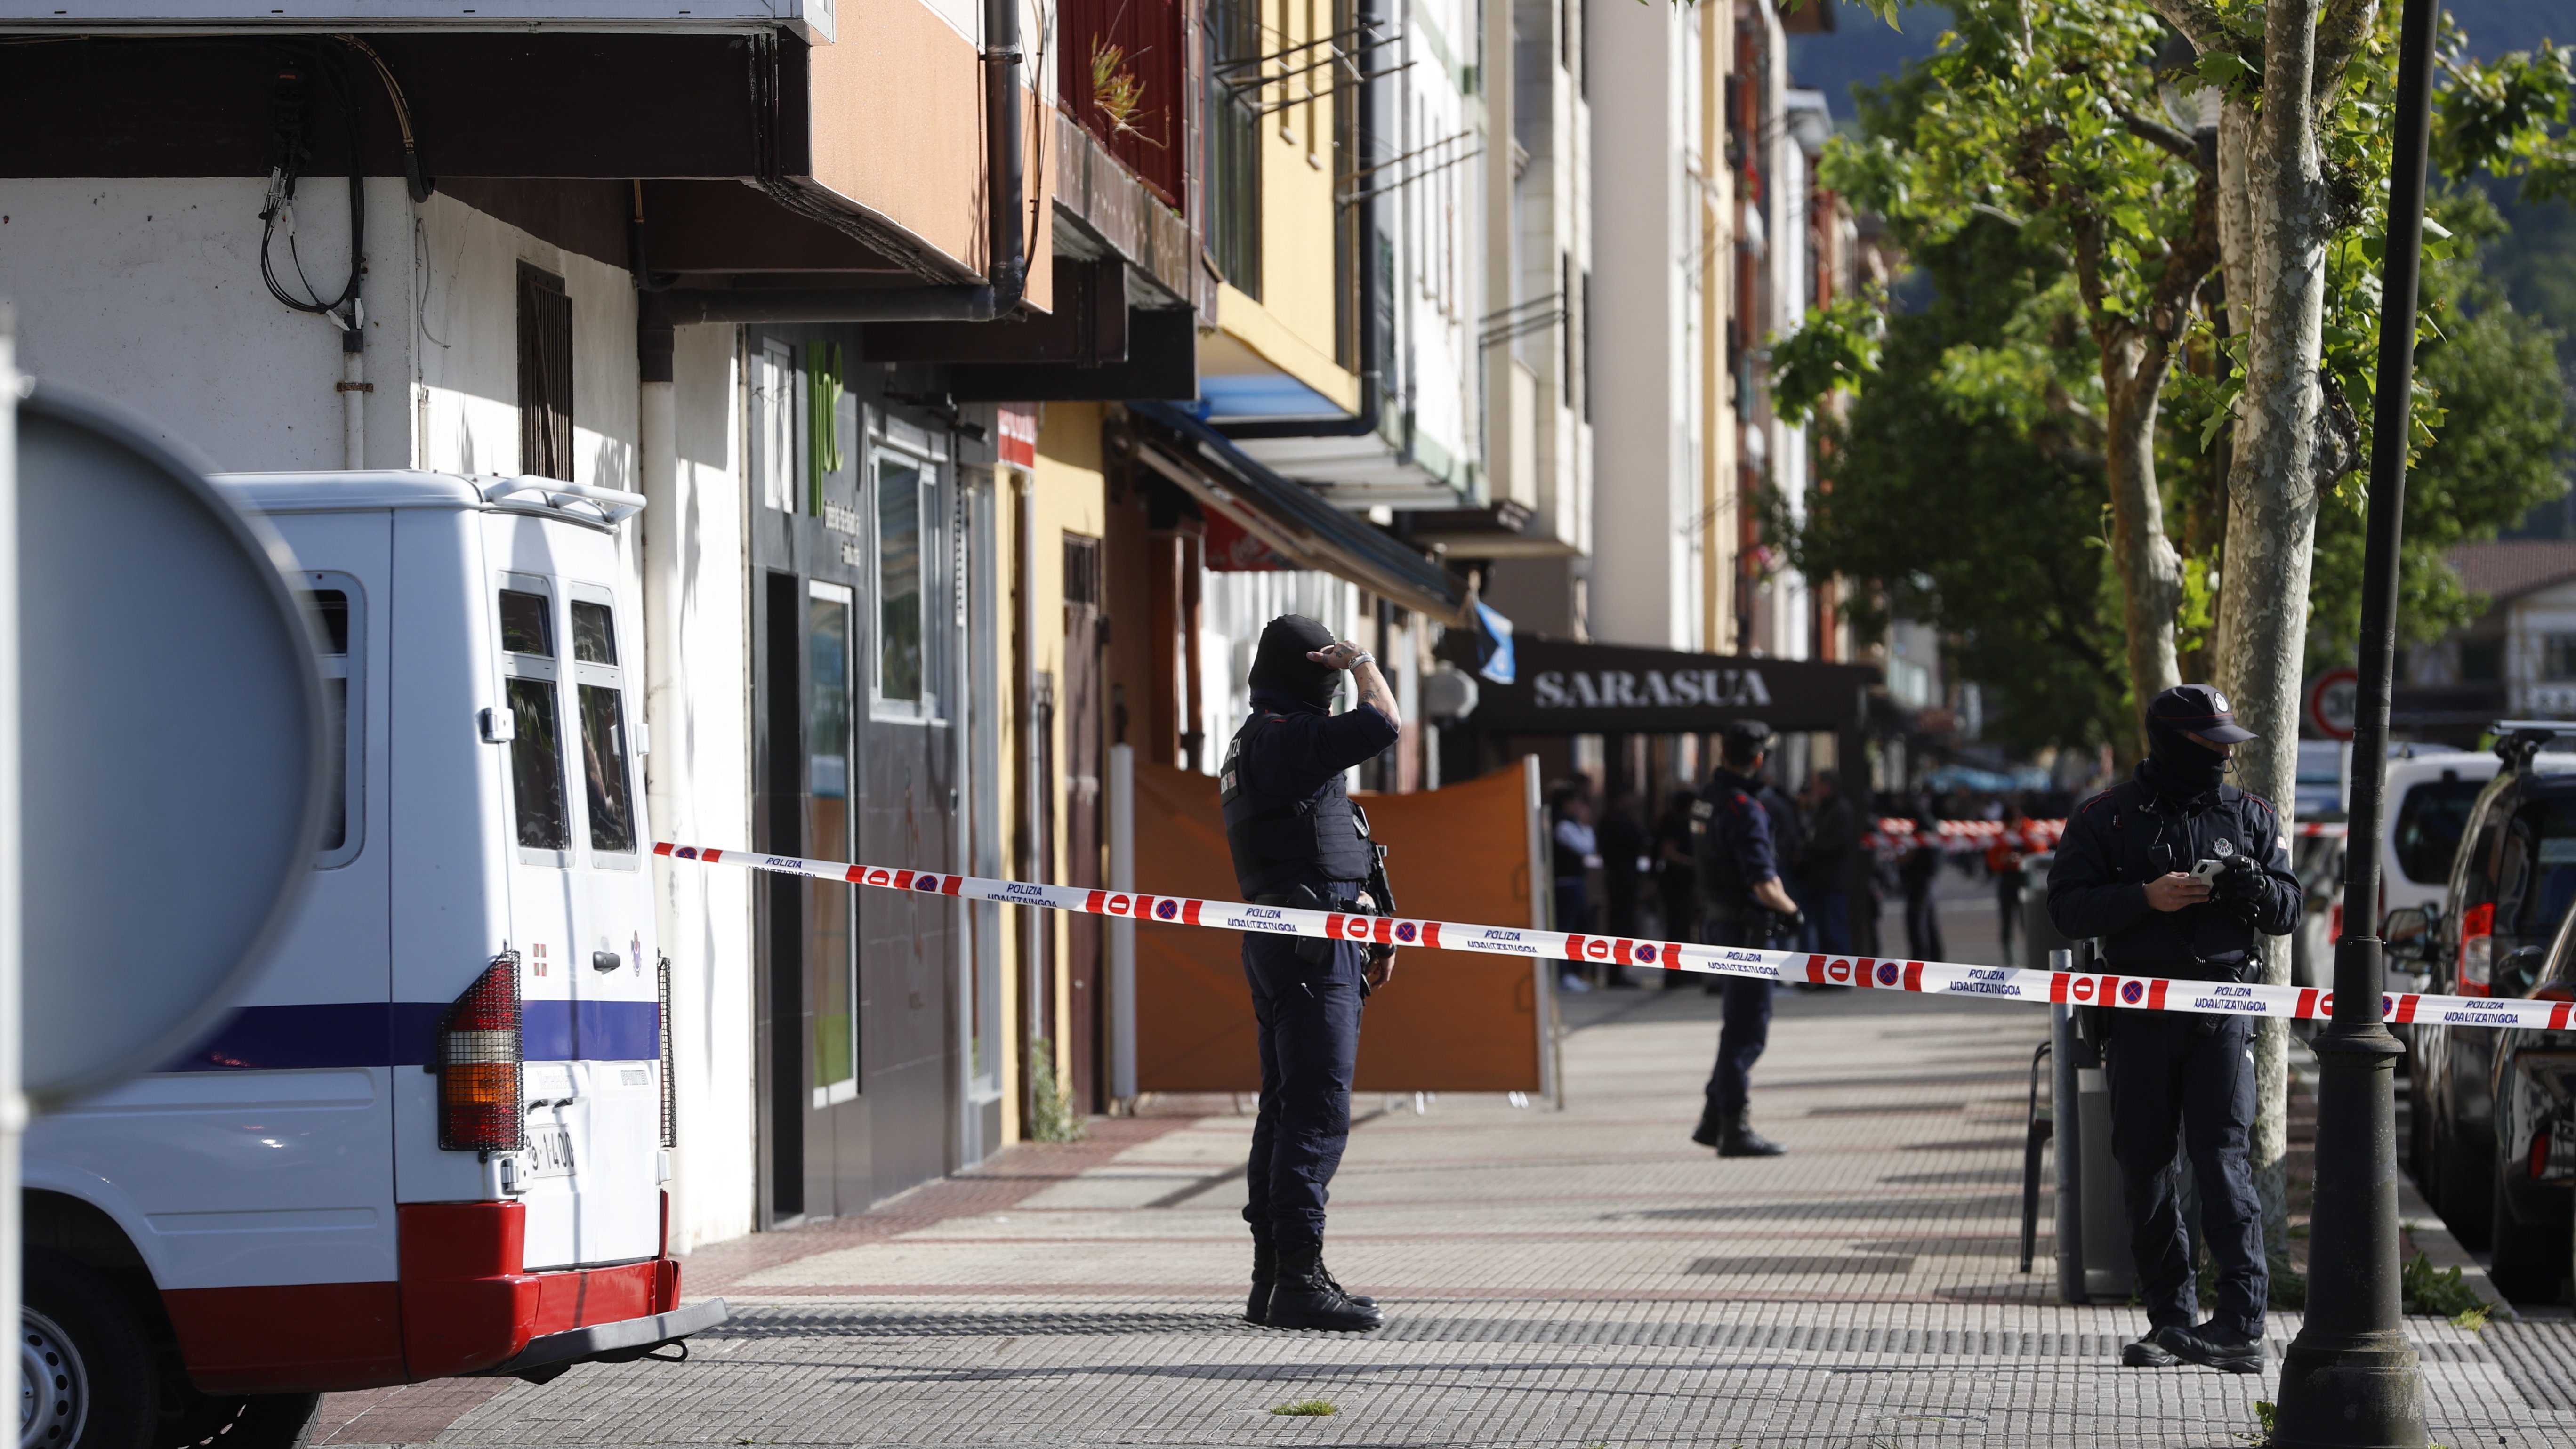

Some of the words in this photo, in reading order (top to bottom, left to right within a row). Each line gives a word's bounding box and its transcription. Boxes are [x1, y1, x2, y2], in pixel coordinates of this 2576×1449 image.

[1533, 668, 1772, 709] SARASUA
[766, 857, 802, 869] POLIZIA
[1006, 884, 1042, 896] POLIZIA
[1246, 908, 1281, 919] POLIZIA
[1484, 930, 1521, 941] POLIZIA
[1726, 951, 1762, 962] POLIZIA
[1968, 969, 2005, 981] POLIZIA
[1950, 981, 2021, 996] UDALTZAINGOA
[2214, 986, 2252, 997] POLIZIA
[2194, 998, 2267, 1012] UDALTZAINGOA
[2465, 1000, 2504, 1010] POLIZIA
[2444, 1011, 2519, 1024] UDALTZAINGOA
